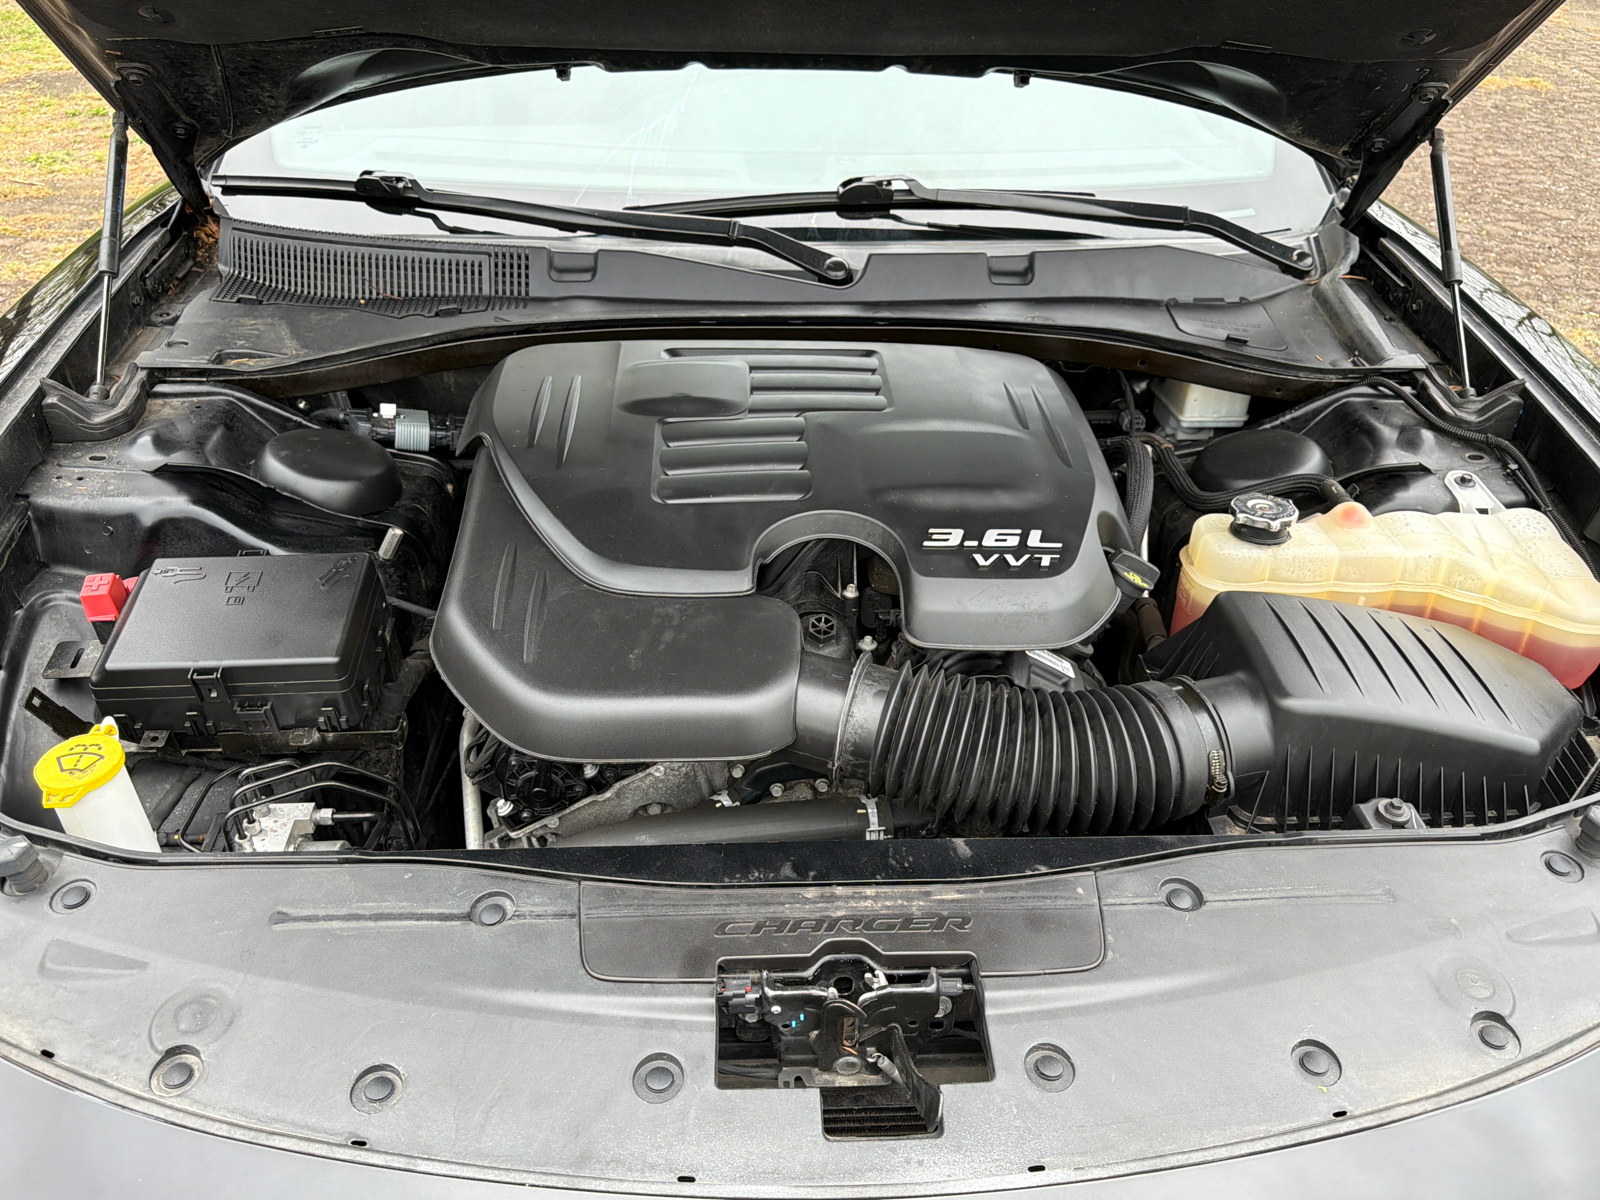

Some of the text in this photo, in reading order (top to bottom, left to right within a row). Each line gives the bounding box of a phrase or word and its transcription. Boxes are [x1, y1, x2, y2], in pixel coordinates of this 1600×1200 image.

[922, 528, 1063, 550] 3.6L
[972, 553, 1060, 568] VVT
[714, 916, 973, 938] CHARGER
